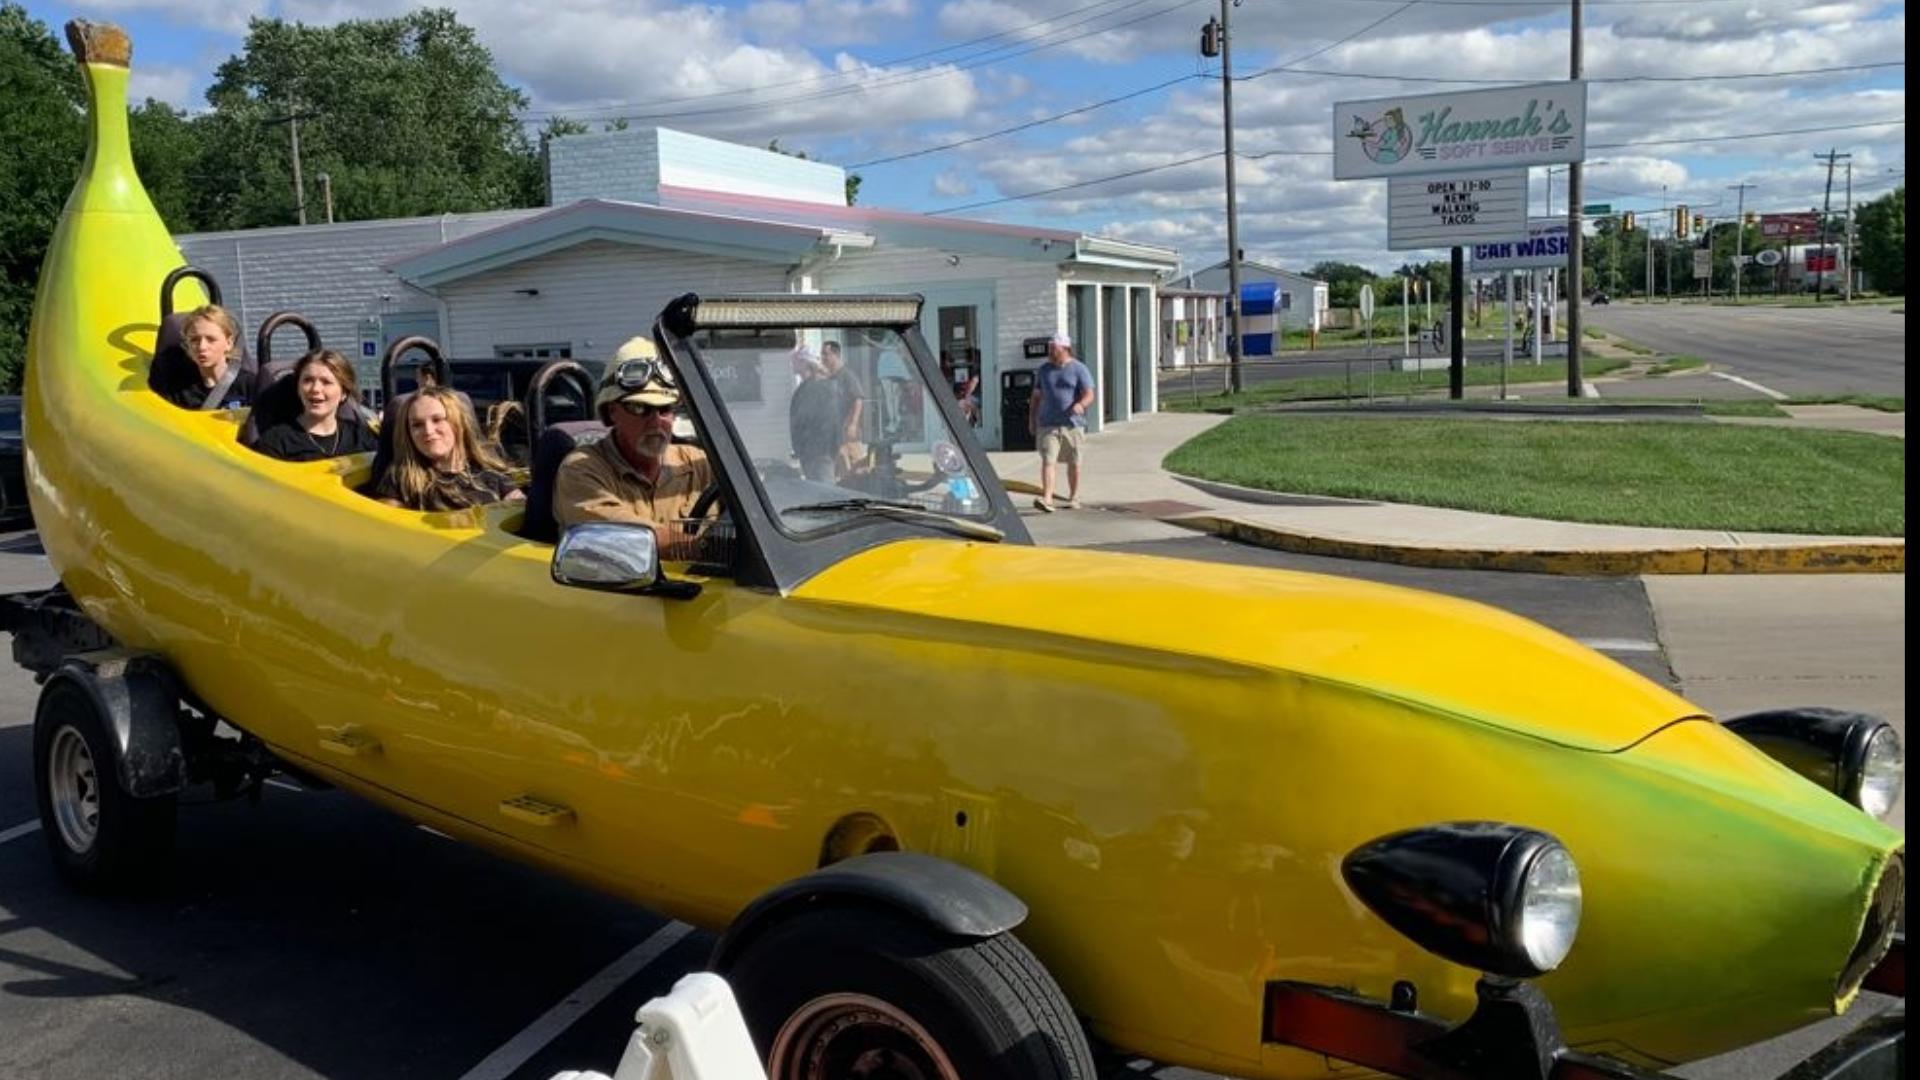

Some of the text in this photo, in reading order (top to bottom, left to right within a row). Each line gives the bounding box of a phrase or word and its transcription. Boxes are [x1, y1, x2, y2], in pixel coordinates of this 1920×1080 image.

[1415, 100, 1572, 147] Hannah's
[1439, 136, 1550, 160] SOFT SERVE
[1427, 182, 1456, 194] OPEN
[1432, 203, 1480, 214] WALKING
[1442, 214, 1476, 224] TACOS
[1517, 236, 1569, 257] WASH
